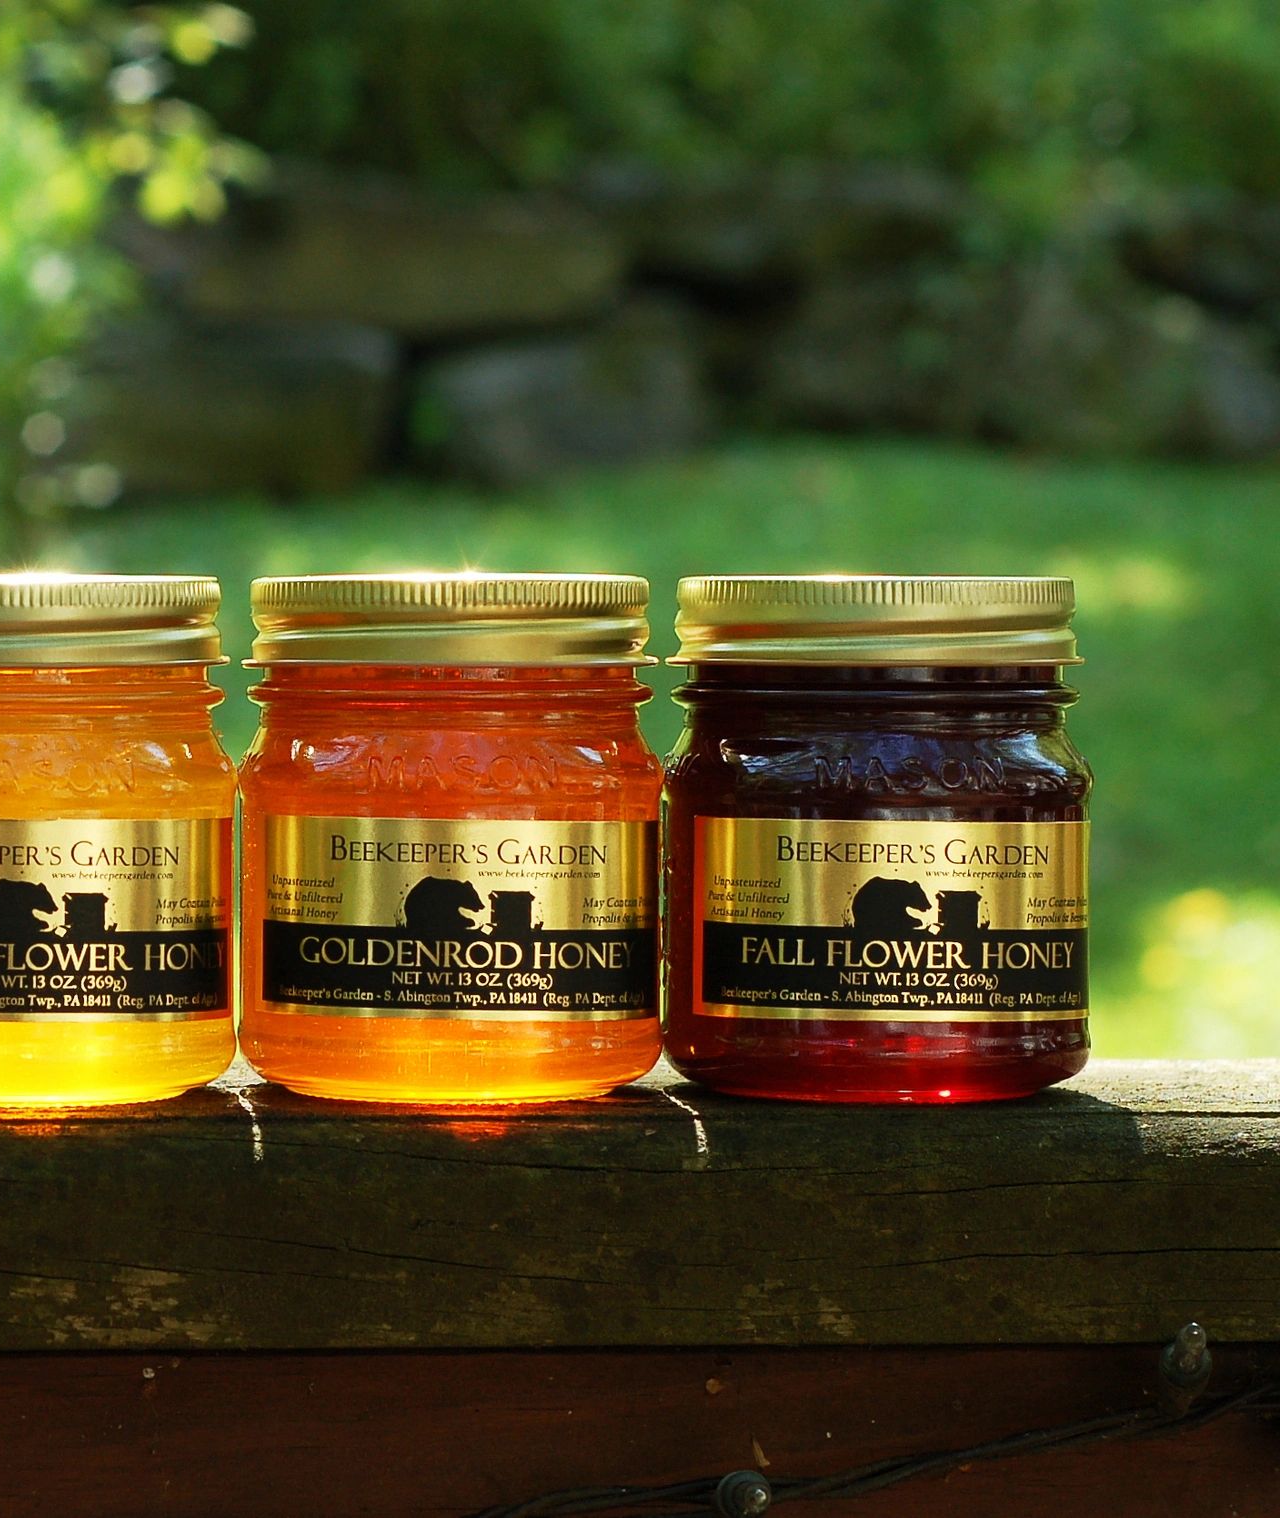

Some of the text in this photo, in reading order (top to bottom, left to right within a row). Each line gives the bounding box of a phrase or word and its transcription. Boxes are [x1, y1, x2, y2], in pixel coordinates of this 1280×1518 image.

[368, 755, 559, 792] MASON
[814, 755, 1006, 791] MASON
[714, 875, 781, 889] Unpasteurized
[156, 899, 177, 909] May
[295, 891, 343, 904] Unfiltered
[583, 897, 604, 909] May
[738, 892, 790, 904] Unfiltered
[1027, 897, 1047, 909] May
[306, 906, 339, 920] Honey
[582, 913, 621, 926] Propolis
[751, 907, 785, 921] Honey
[1027, 913, 1060, 926] Propolis
[155, 915, 193, 928] Propolis
[299, 936, 633, 969] GOLDENROD HONEY
[742, 937, 1074, 970] FALL FLOWER HONEY
[1, 975, 28, 989] WT.
[32, 976, 46, 988] 13
[81, 976, 127, 992] (369g)
[392, 971, 422, 985] NET
[427, 972, 454, 986] WT.
[458, 973, 472, 986] 13
[506, 973, 553, 990] (369g)
[839, 971, 870, 985] NET
[874, 972, 902, 987] WT.
[905, 973, 919, 987] 13
[953, 973, 999, 990] (369g)
[64, 995, 80, 1007] PA
[83, 995, 111, 1007] 18411
[149, 995, 163, 1006] PA
[333, 988, 374, 1001] Garden
[384, 990, 394, 1001] S.
[398, 990, 450, 1005] Abington
[489, 992, 506, 1004] PA
[509, 992, 537, 1004] 18411
[575, 993, 589, 1004] PA
[779, 989, 821, 1001] Garden
[831, 991, 842, 1001] S.
[845, 991, 899, 1006] Abington
[937, 992, 954, 1004] PA
[955, 993, 983, 1005] 18411
[1020, 993, 1033, 1004] PA
